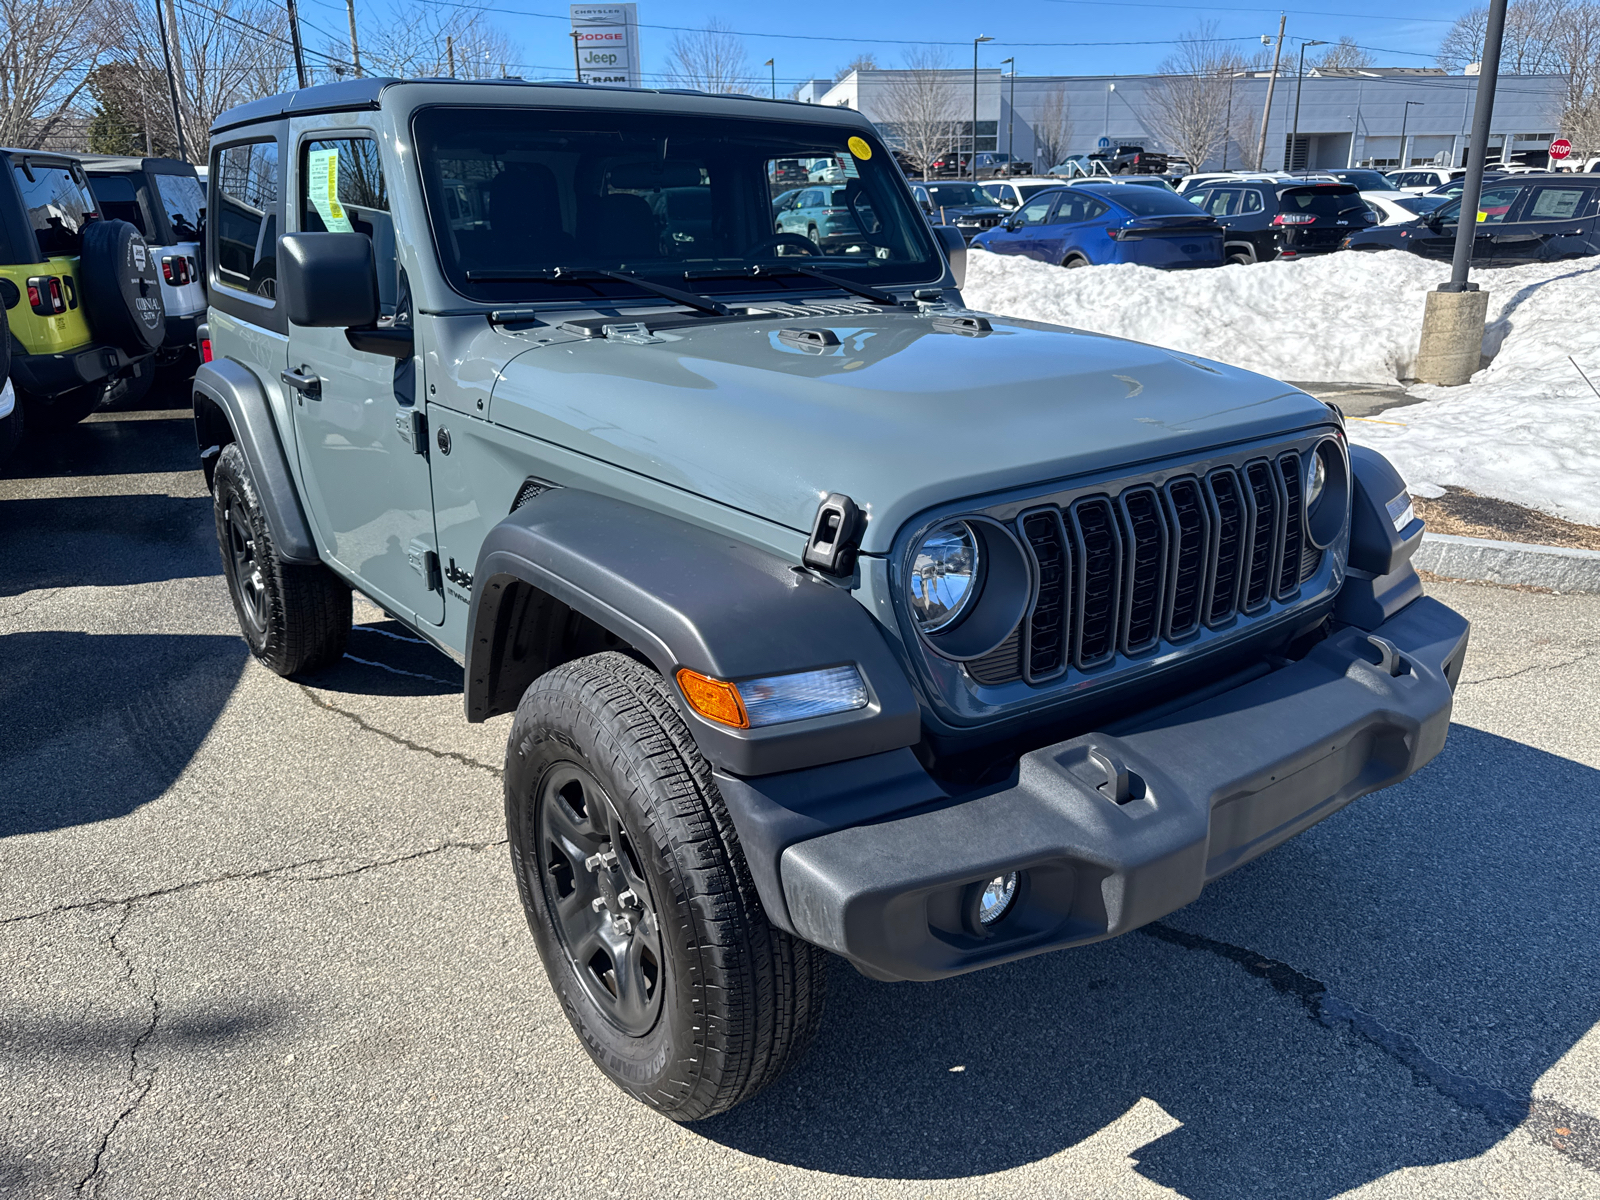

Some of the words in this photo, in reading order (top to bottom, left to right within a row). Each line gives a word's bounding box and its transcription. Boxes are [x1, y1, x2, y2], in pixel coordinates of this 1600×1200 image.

[576, 33, 623, 41] DODGE
[584, 51, 617, 65] Jeep
[1551, 145, 1570, 154] STOP
[445, 556, 474, 592] Jee
